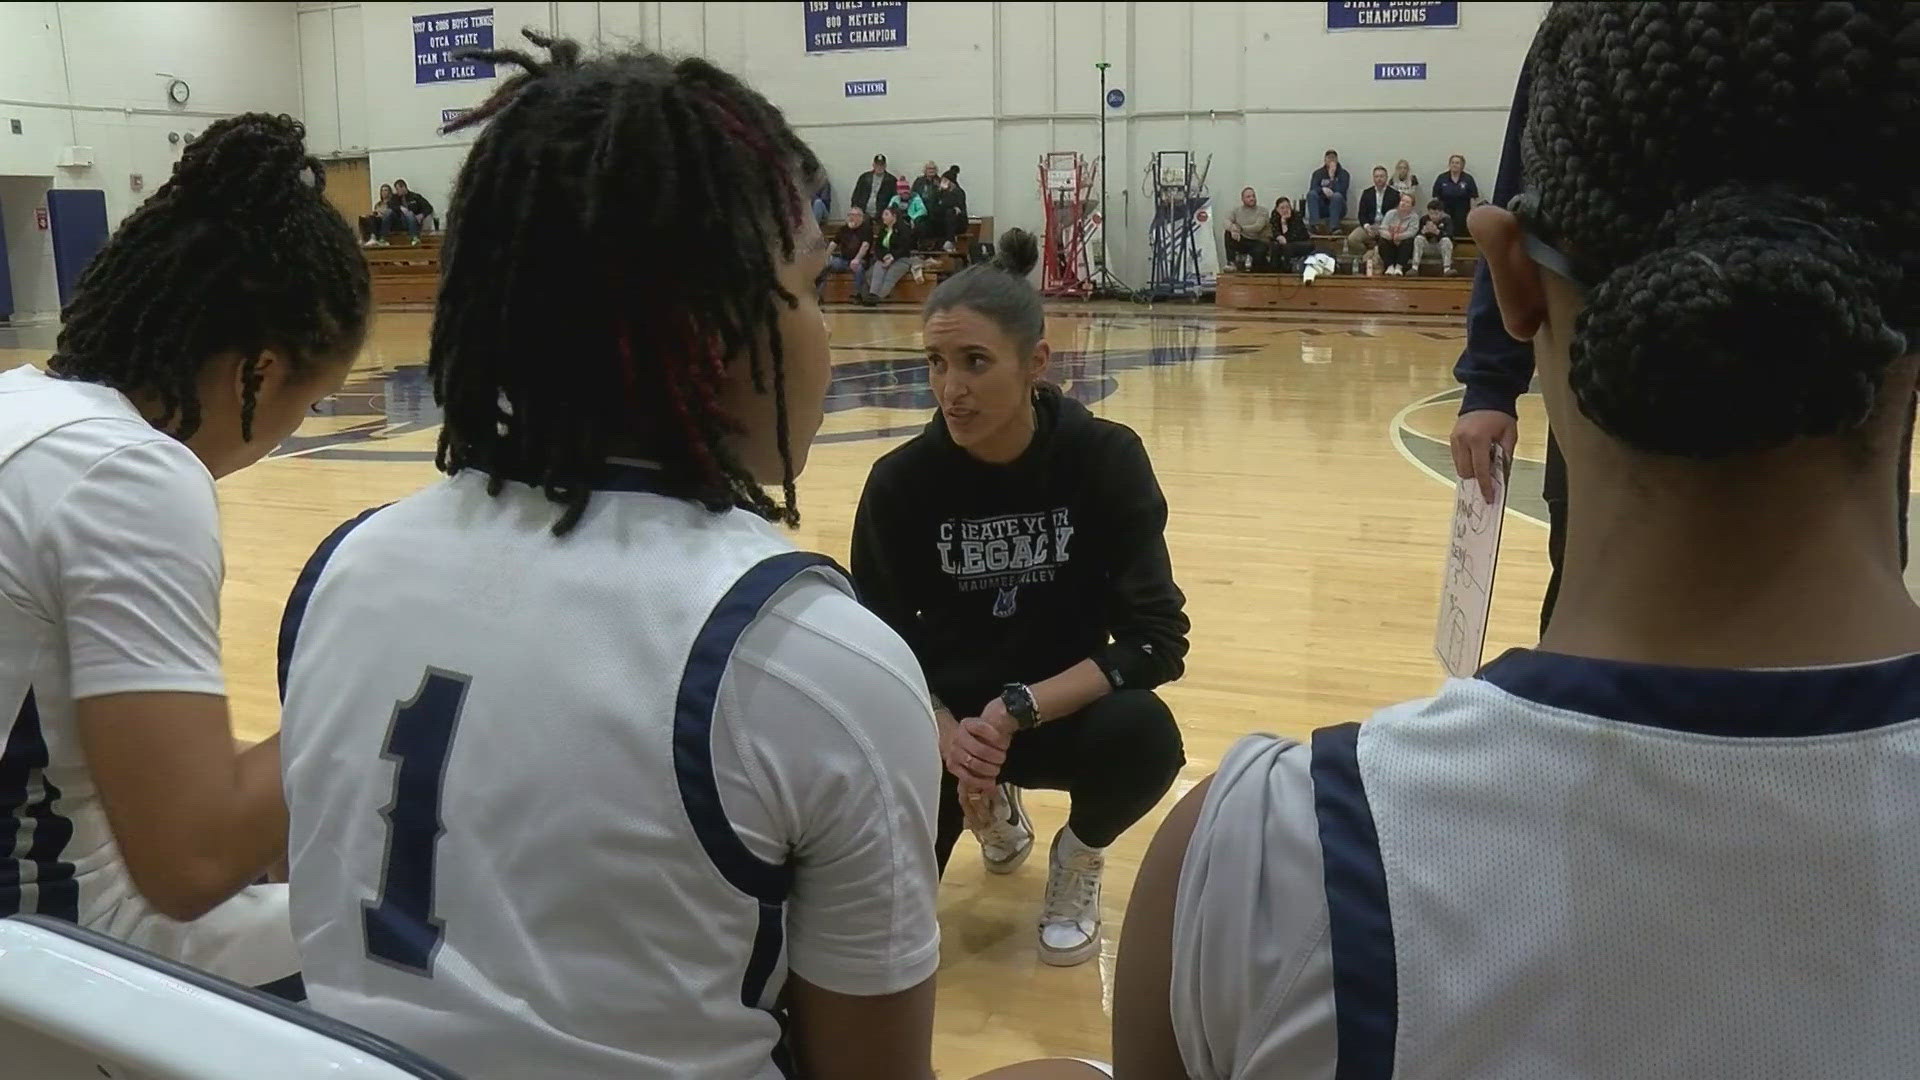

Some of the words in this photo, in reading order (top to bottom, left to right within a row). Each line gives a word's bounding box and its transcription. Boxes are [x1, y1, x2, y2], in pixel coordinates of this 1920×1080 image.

[451, 17, 468, 29] BOYS
[826, 15, 841, 28] 800
[848, 13, 885, 26] METERS
[1358, 8, 1426, 24] CHAMPIONS
[430, 35, 450, 48] OTCA
[455, 33, 478, 46] STATE
[814, 32, 843, 46] STATE
[849, 29, 897, 43] CHAMPION
[418, 53, 438, 65] TEAM
[451, 66, 475, 78] PLACE
[1381, 66, 1420, 77] HOME
[847, 83, 884, 95] VISITOR
[937, 526, 1074, 575] LEGACY
[361, 664, 473, 979] 1
